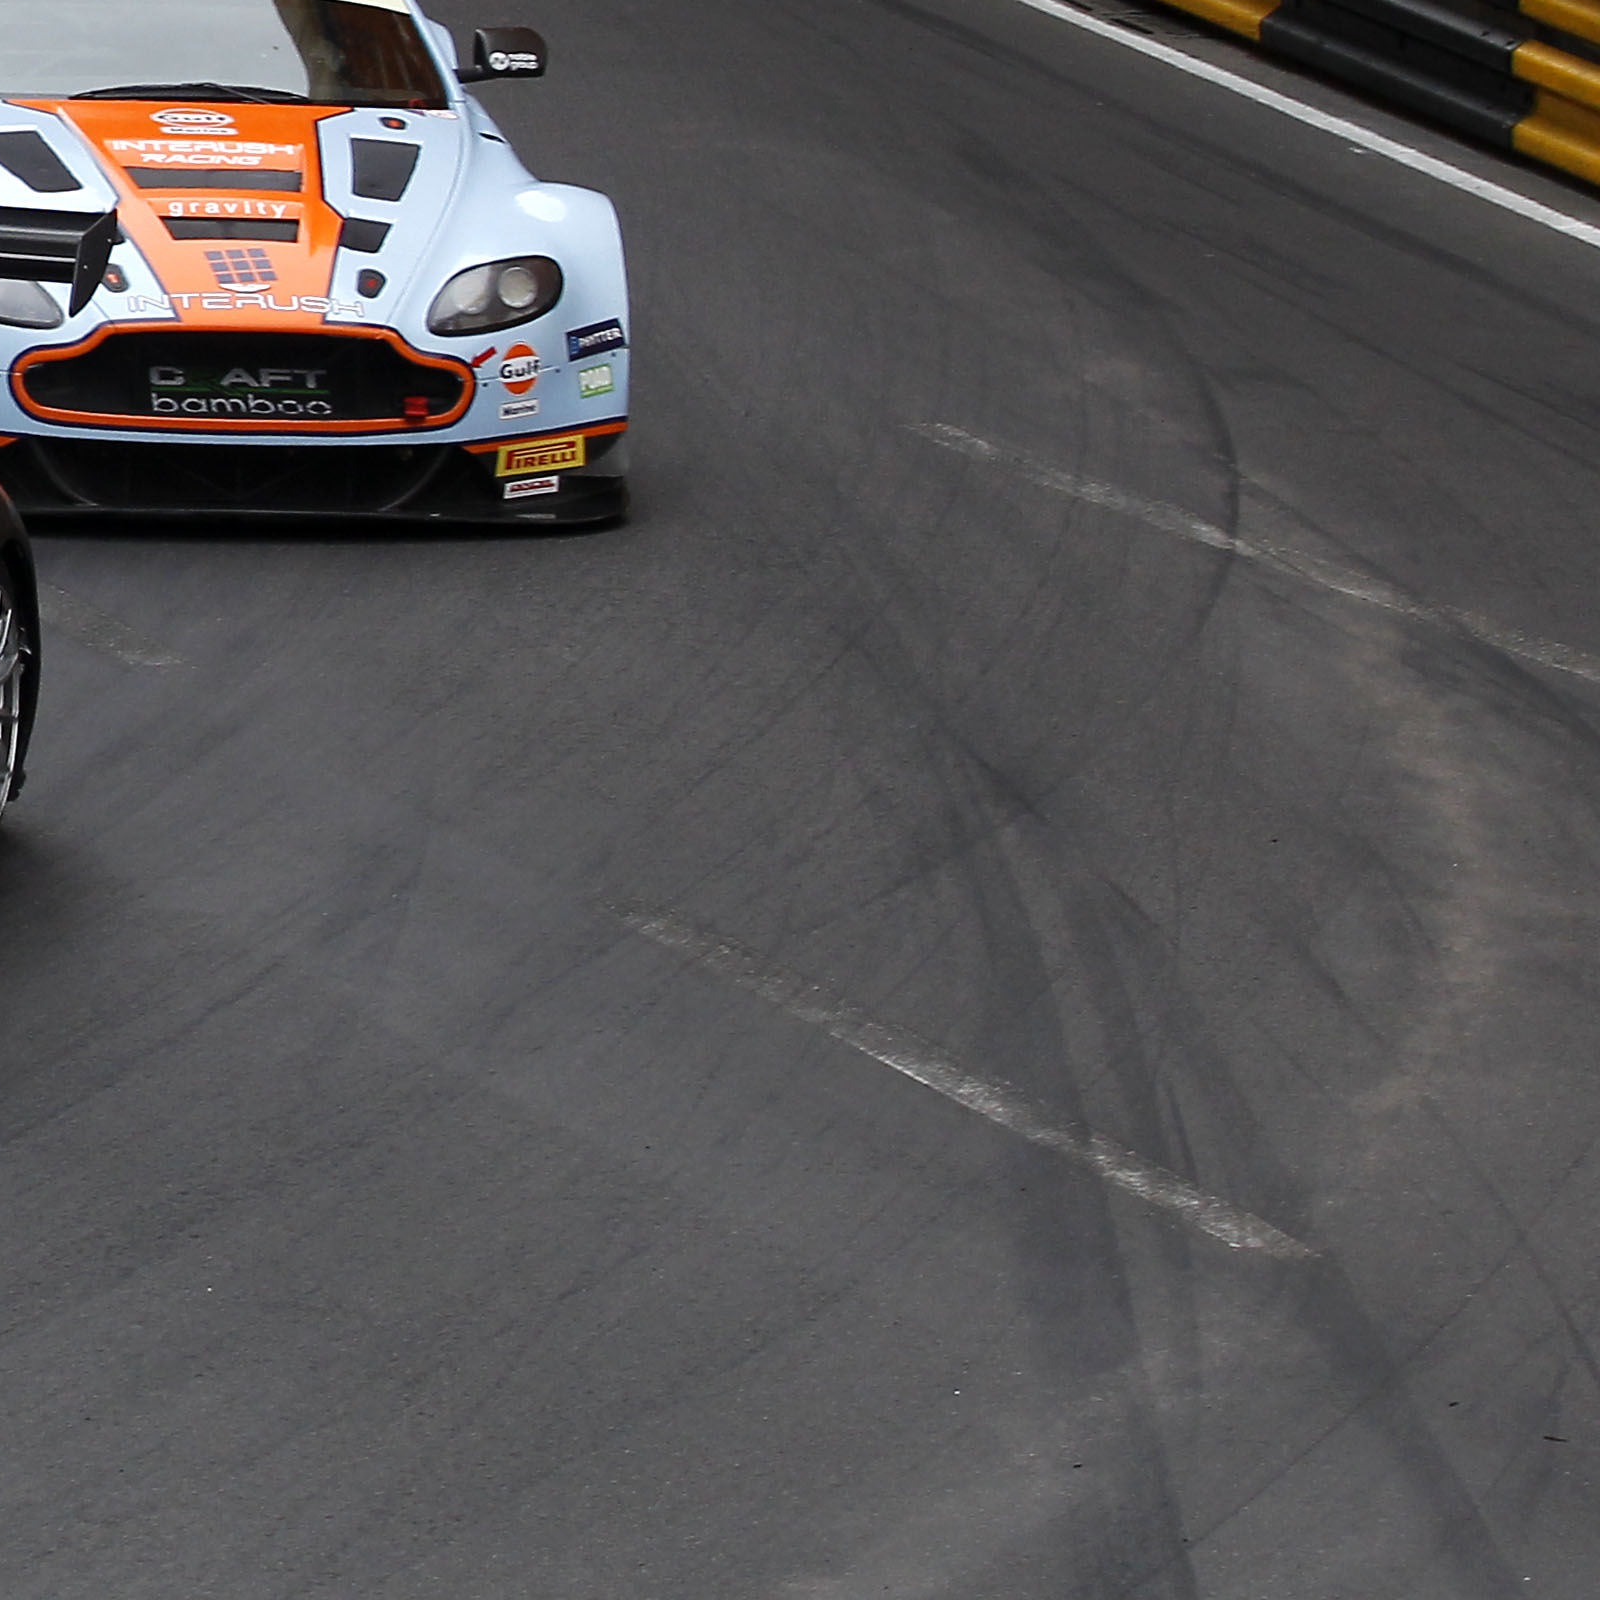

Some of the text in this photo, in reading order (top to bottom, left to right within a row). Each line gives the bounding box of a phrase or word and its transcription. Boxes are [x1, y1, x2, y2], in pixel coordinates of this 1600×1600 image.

[110, 138, 296, 156] INTERUSH
[139, 153, 263, 166] RACING
[168, 201, 287, 219] gravity
[127, 292, 366, 318] INTERUSH
[150, 365, 328, 389] CAFT
[500, 359, 542, 380] Gulf
[151, 392, 333, 416] bamboo
[505, 441, 576, 471] PIRELLI
